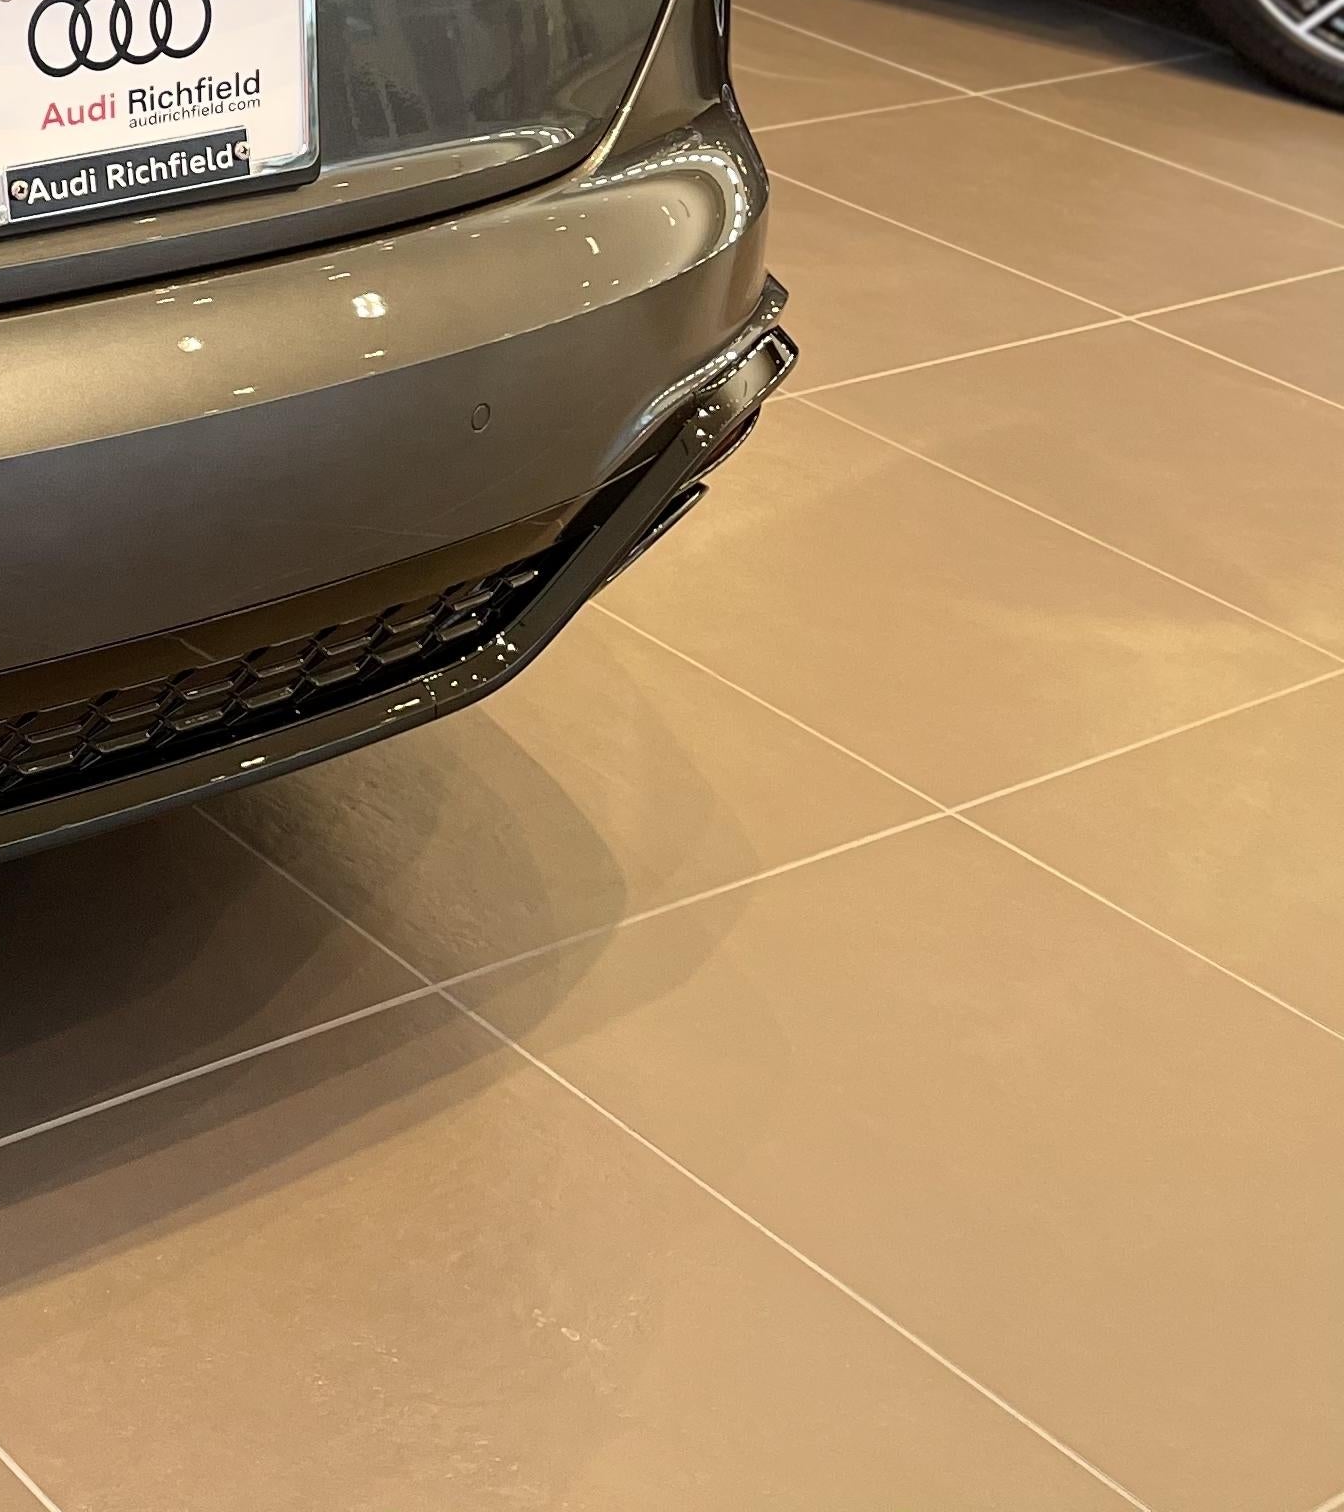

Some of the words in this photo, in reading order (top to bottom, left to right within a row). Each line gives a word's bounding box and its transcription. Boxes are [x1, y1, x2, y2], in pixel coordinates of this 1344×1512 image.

[41, 93, 116, 130] Audi
[128, 69, 261, 114] Richfield
[129, 98, 261, 129] audirichfieldcom
[28, 168, 98, 205] Audi
[106, 143, 235, 190] Richfield
